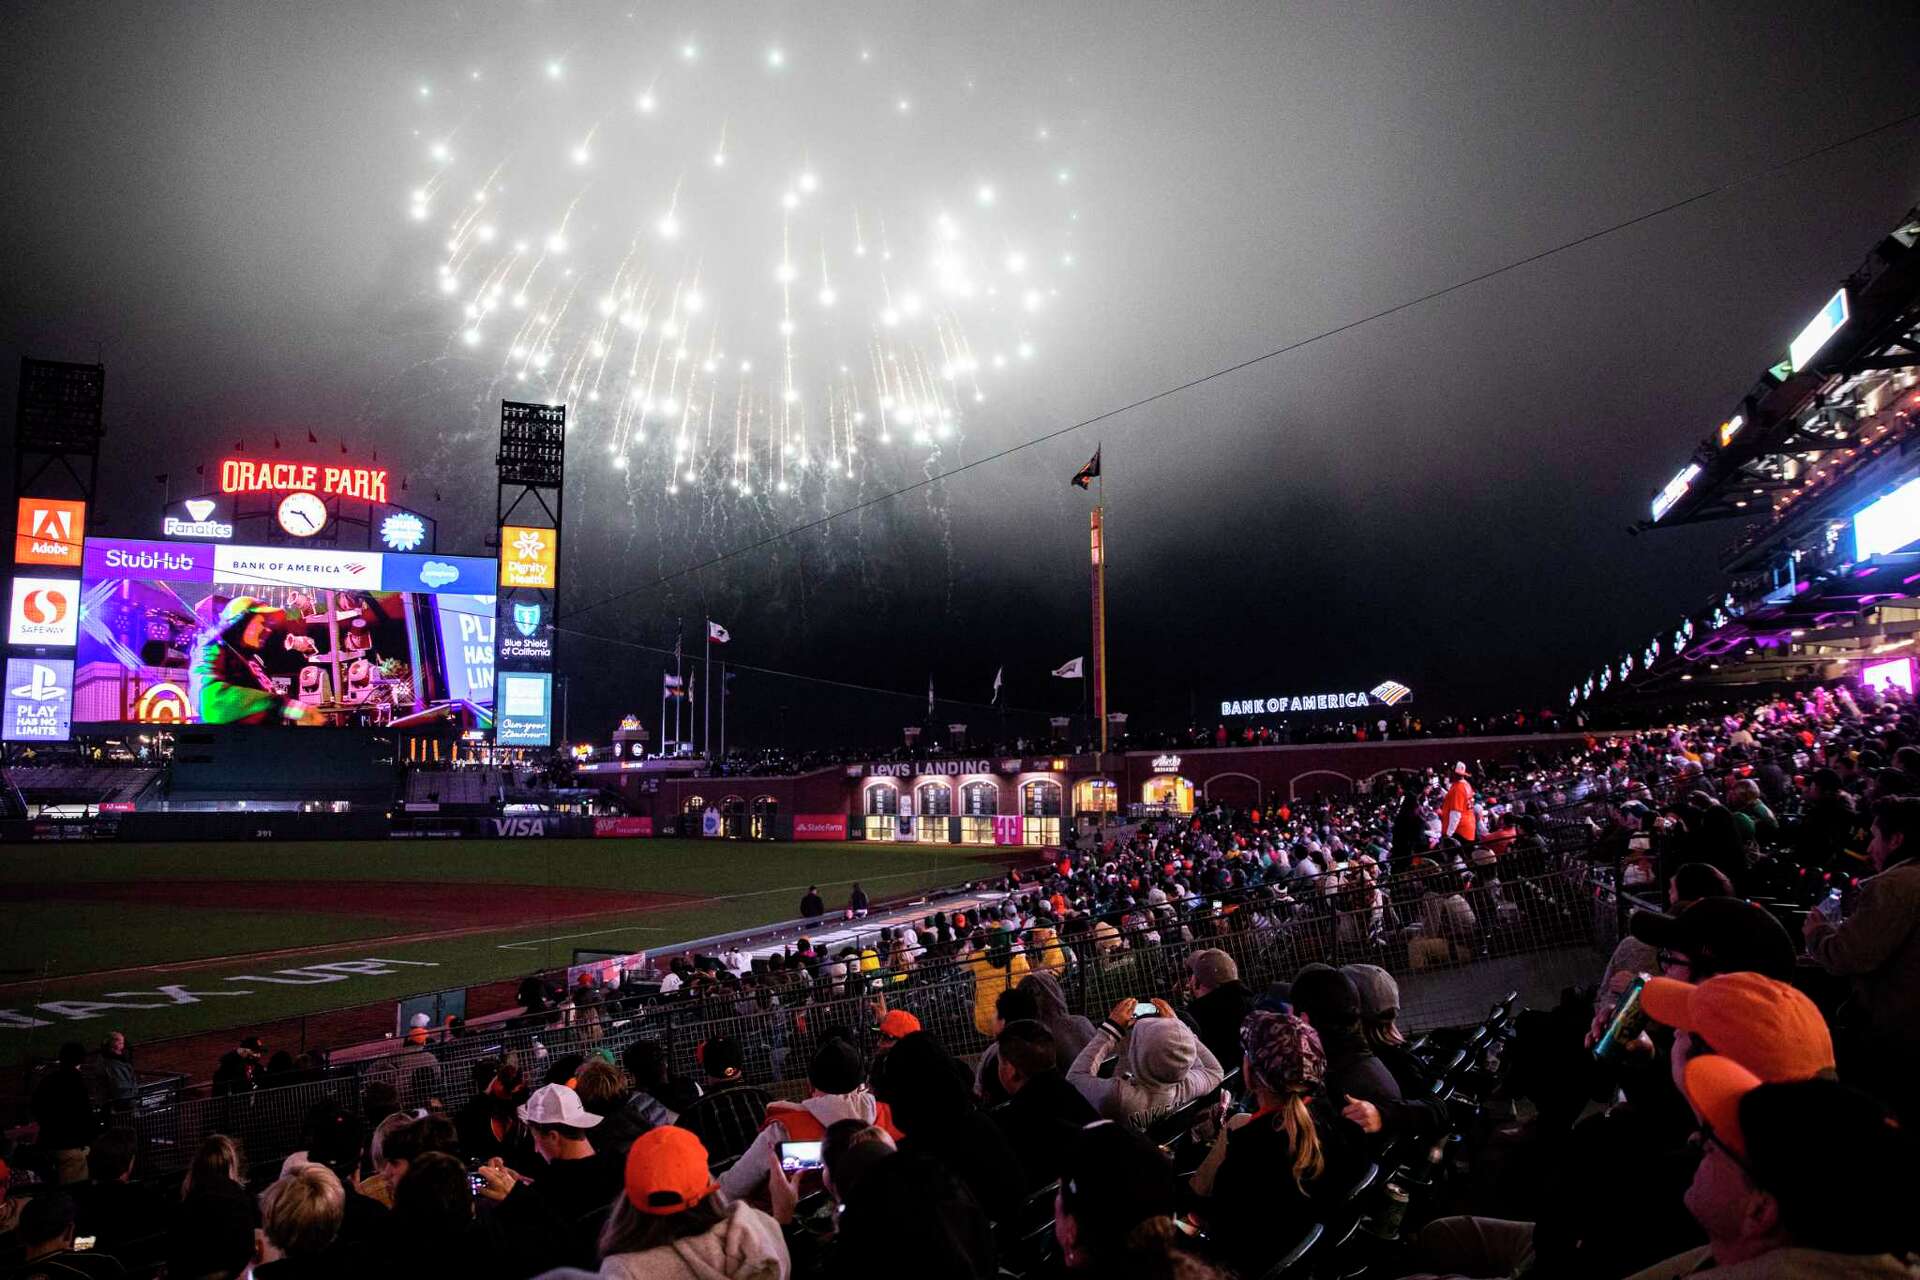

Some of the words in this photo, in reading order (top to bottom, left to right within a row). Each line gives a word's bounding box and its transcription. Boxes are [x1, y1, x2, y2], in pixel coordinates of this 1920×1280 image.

[221, 460, 317, 492] ORACLE
[324, 467, 388, 503] PARK
[165, 518, 232, 538] Fanatics
[31, 542, 69, 555] Adobe
[105, 550, 194, 571] StubHub
[233, 561, 265, 571] BANK
[269, 562, 283, 571] OF
[287, 564, 340, 573] AMERICA
[508, 561, 548, 575] Dignity
[21, 625, 64, 635] SAFEWAY
[504, 639, 522, 648] Blue
[523, 639, 548, 649] Shield
[501, 647, 511, 656] of
[511, 648, 551, 657] California
[1221, 700, 1264, 715] BANK
[1267, 698, 1288, 712] OF
[1290, 692, 1369, 711] AMERICA
[17, 704, 58, 717] PLAY
[17, 717, 39, 726] HAS
[40, 718, 57, 726] NO
[915, 760, 991, 775] LANDING
[493, 818, 545, 837] VISA
